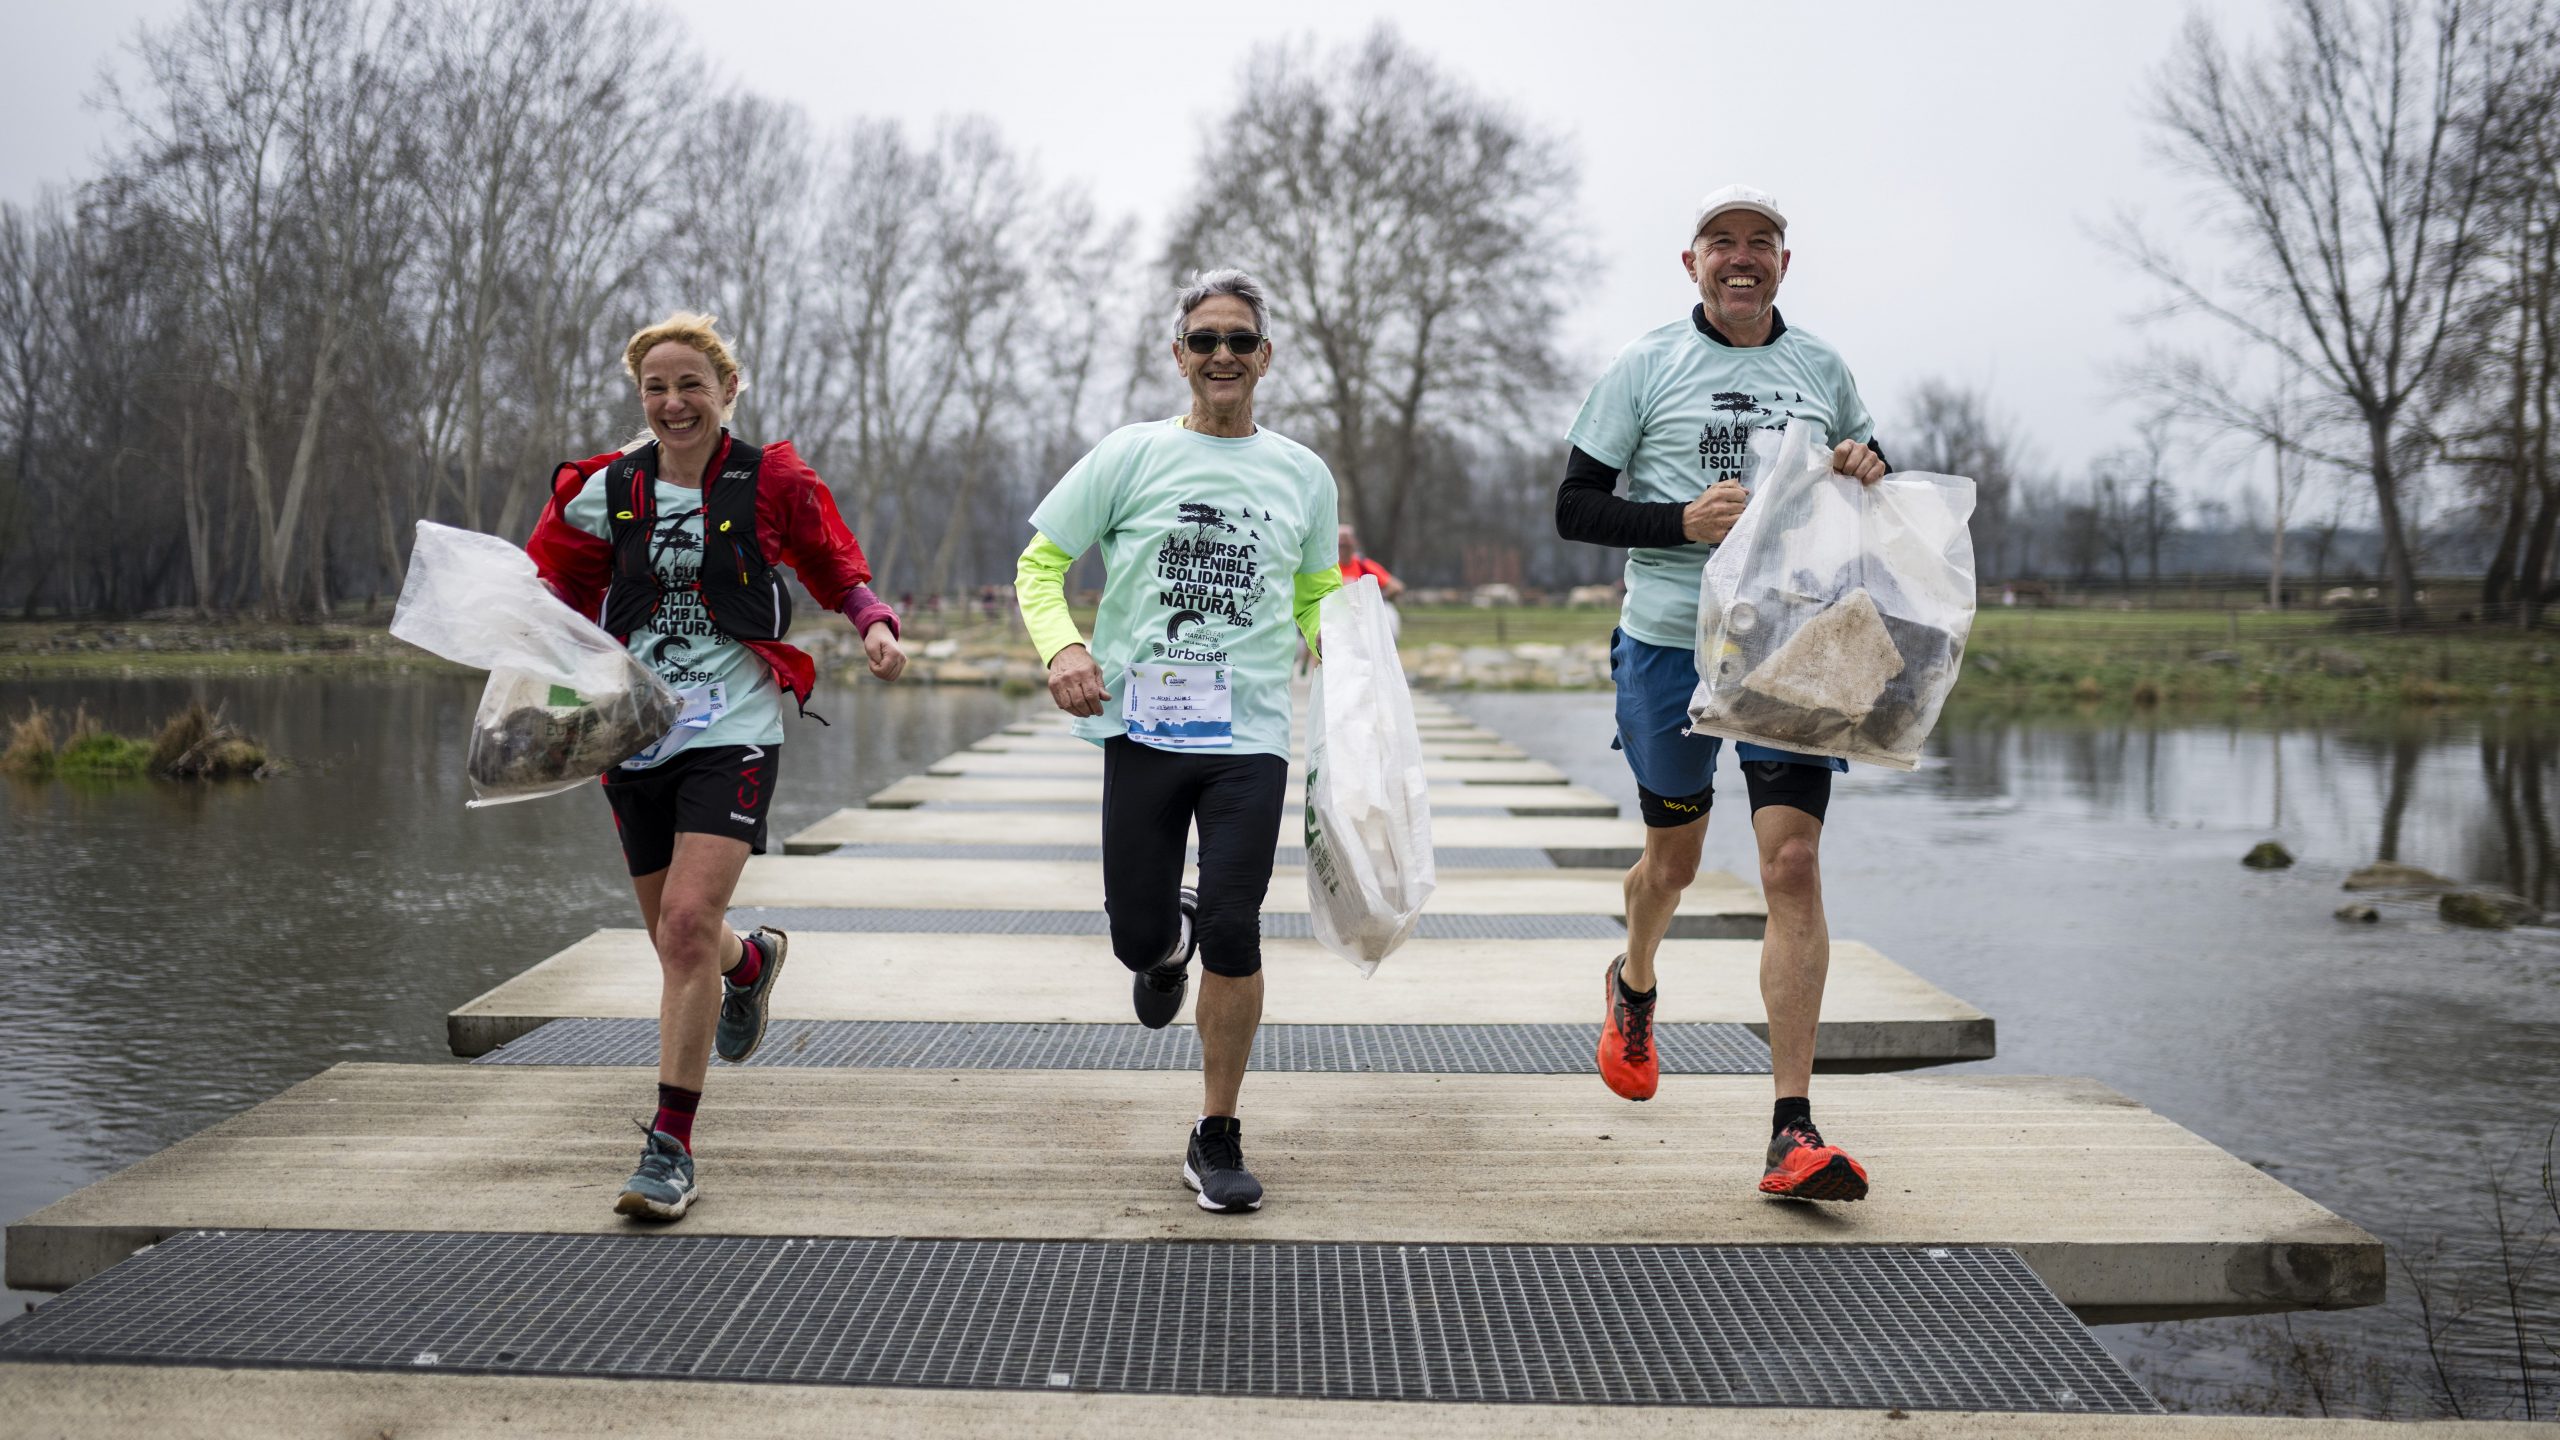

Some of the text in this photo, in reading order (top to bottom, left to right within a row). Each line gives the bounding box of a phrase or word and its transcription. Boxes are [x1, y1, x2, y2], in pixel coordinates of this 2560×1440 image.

[1706, 426, 1730, 440] LA
[1701, 455, 1706, 470] I
[1168, 536, 1249, 560] LA CURSA
[1157, 549, 1257, 576] SOSTENIBLE
[1157, 564, 1252, 589] I SOLIDARIA
[1172, 581, 1234, 600] AMB LA
[1159, 591, 1236, 616] NATURA
[657, 607, 690, 620] AMB
[648, 619, 721, 636] NATURA
[1227, 615, 1254, 628] 2024
[1184, 632, 1219, 643] MARATHON
[1167, 647, 1228, 662] urbaser
[661, 670, 714, 683] rbaser
